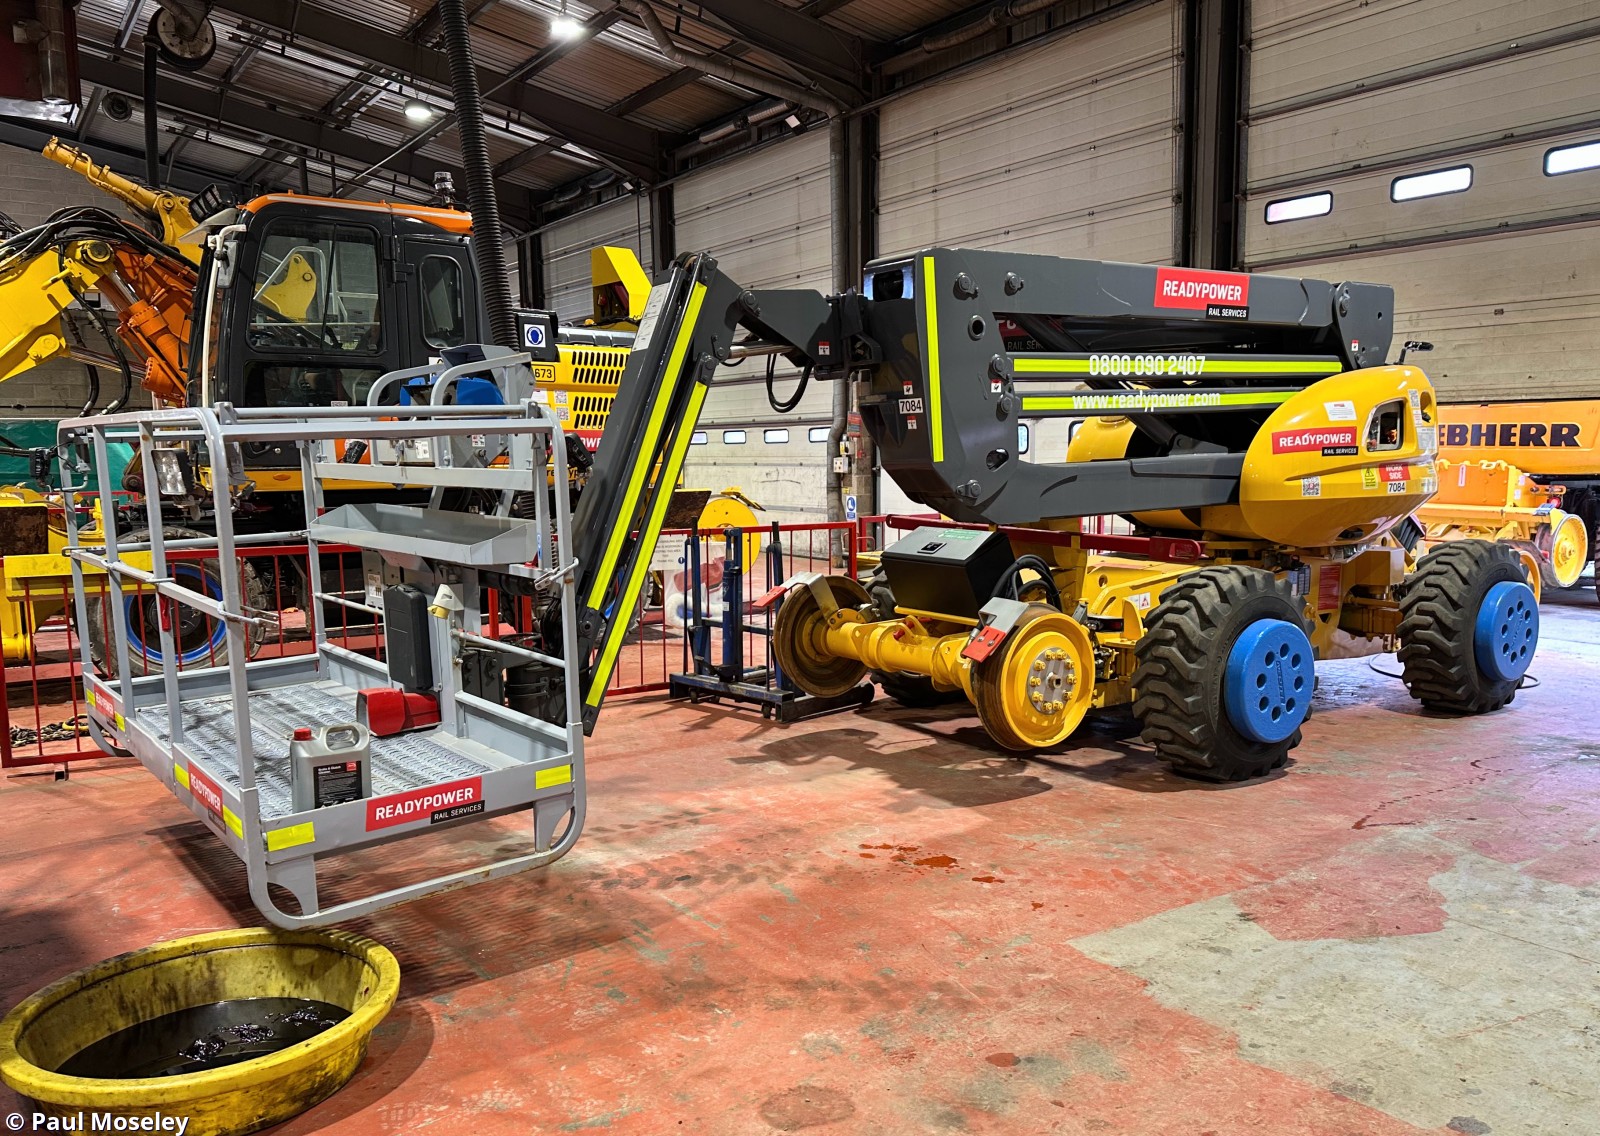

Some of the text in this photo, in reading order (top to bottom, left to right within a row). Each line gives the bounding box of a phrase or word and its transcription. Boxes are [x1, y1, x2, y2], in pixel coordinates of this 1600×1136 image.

[1162, 279, 1242, 301] READYPOWER
[1208, 307, 1247, 318] RAIL SERVICES
[1089, 354, 1206, 376] 0800 090 2407
[900, 400, 922, 412] 7084
[1072, 390, 1221, 413] www.readypower.com
[1278, 432, 1352, 448] READYPOWER
[1335, 447, 1357, 455] SERVICES
[1388, 471, 1403, 480] SIDE
[1388, 482, 1406, 492] 7084
[190, 772, 221, 812] READYPOWER
[375, 787, 474, 821] READYPOWER
[434, 803, 482, 821] RAIL SERVICES
